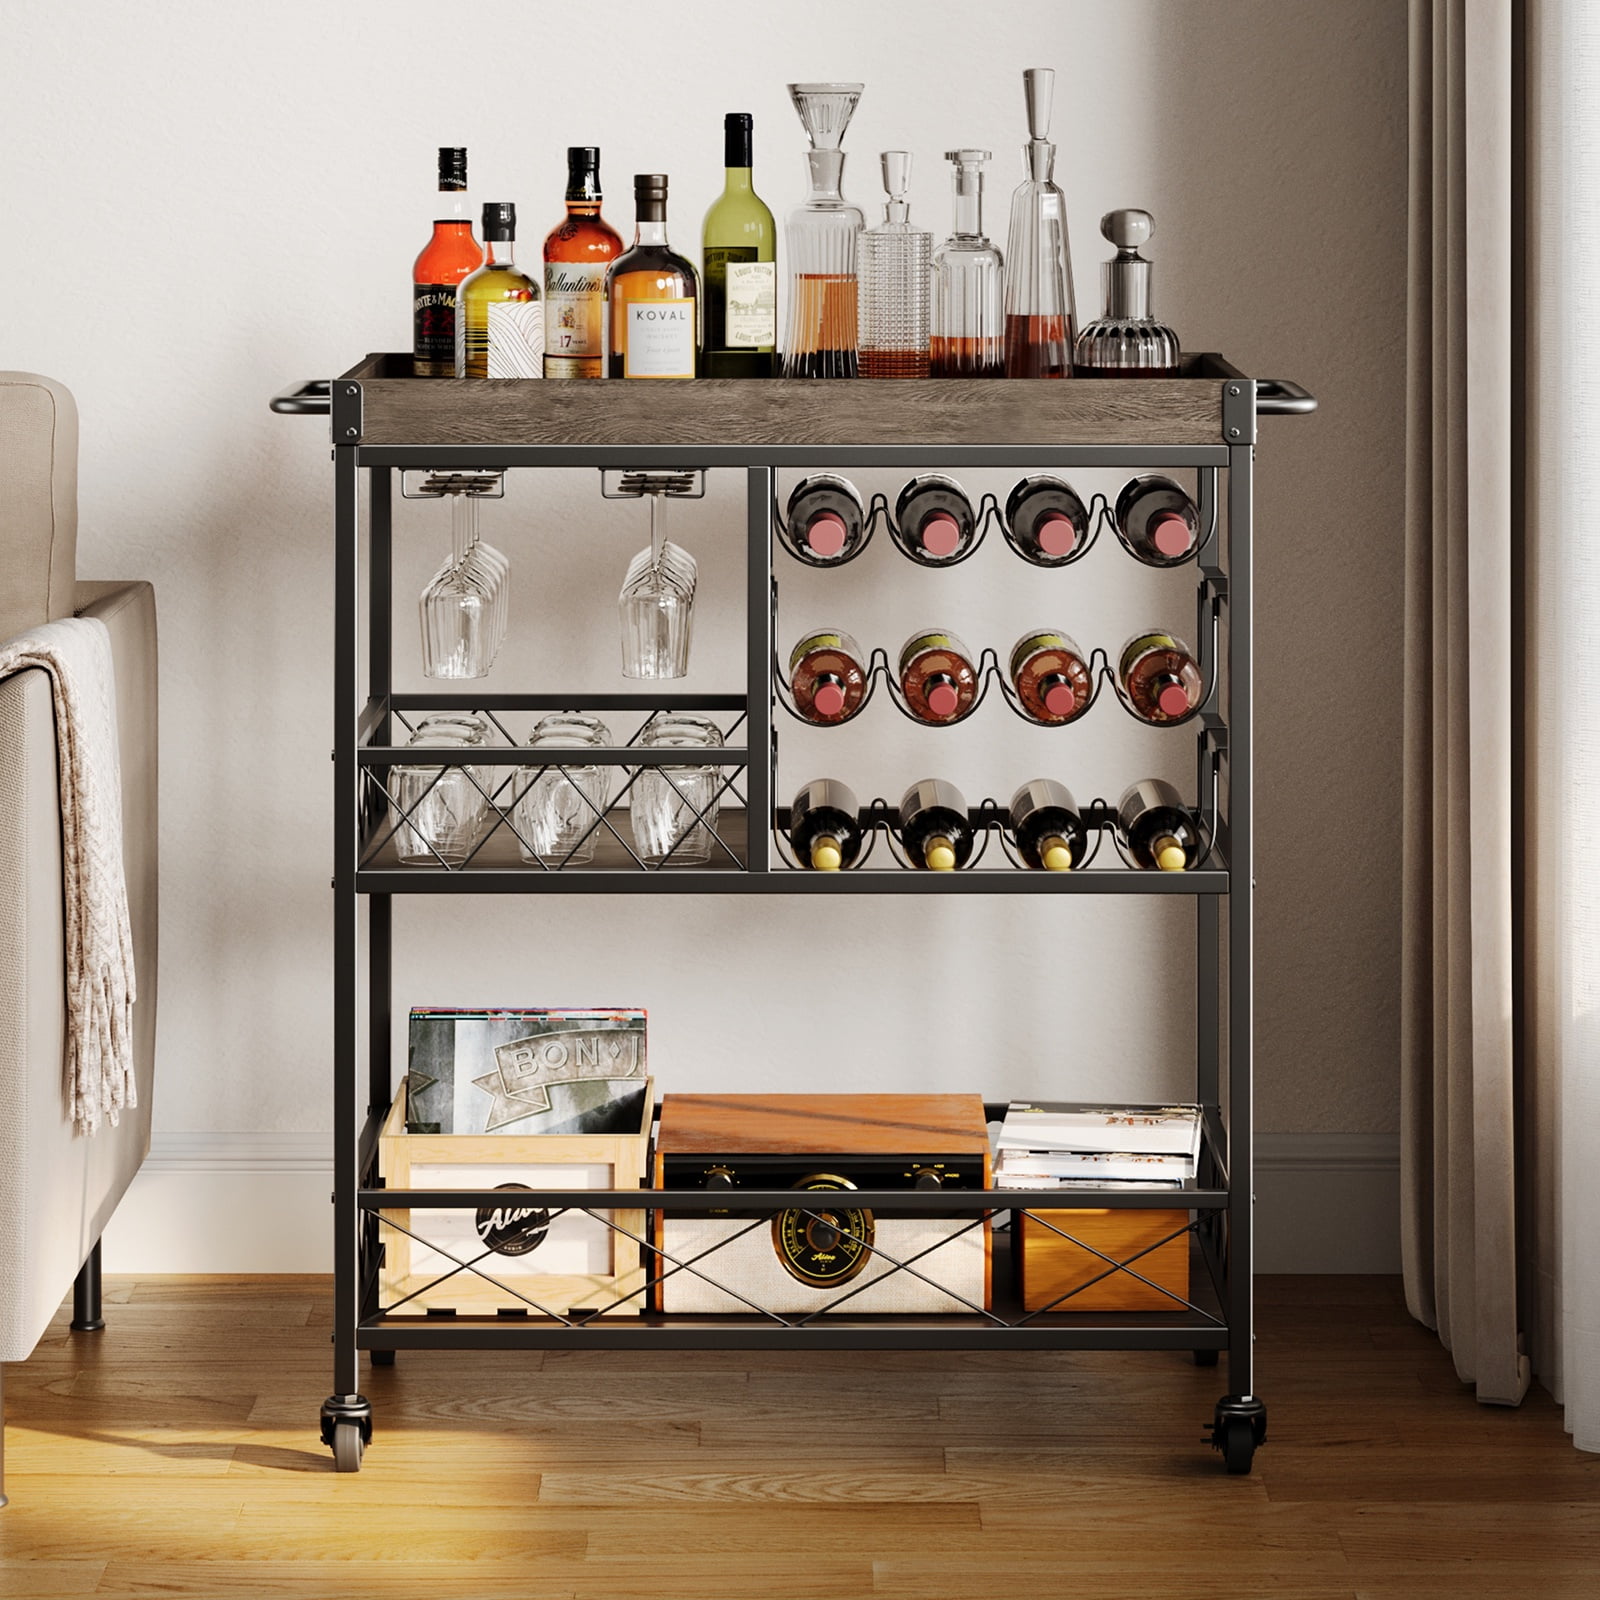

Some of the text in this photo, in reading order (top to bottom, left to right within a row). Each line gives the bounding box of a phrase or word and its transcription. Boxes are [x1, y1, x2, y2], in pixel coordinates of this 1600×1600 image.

[544, 267, 600, 292] Ballantine's
[636, 310, 686, 321] KOVAL
[560, 335, 572, 348] 17
[511, 1036, 600, 1080] BON
